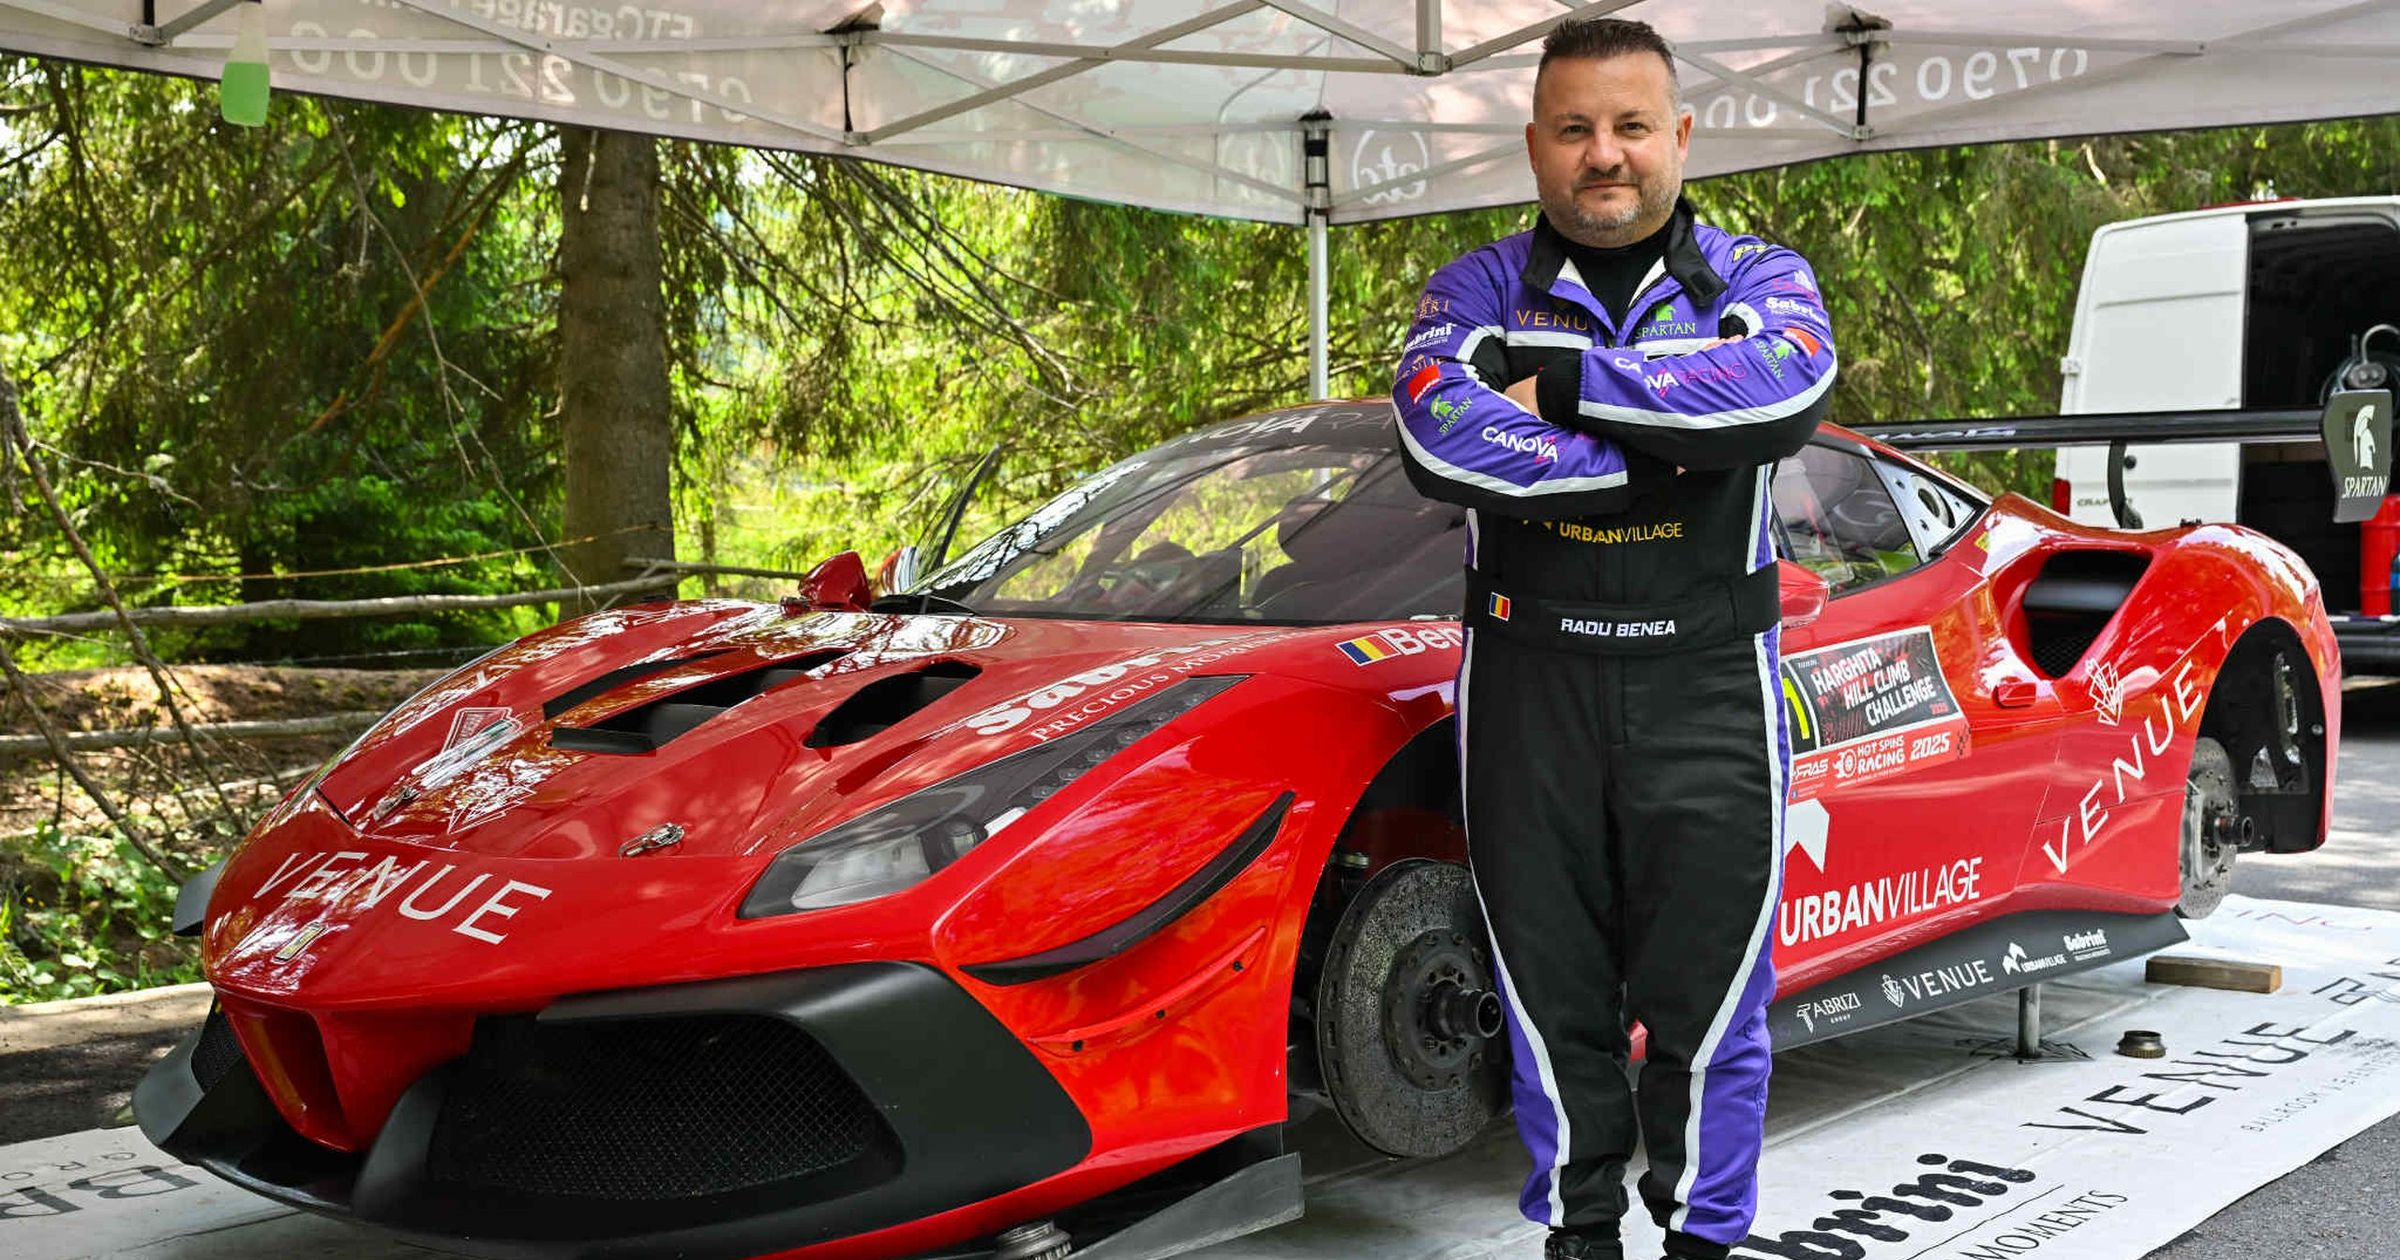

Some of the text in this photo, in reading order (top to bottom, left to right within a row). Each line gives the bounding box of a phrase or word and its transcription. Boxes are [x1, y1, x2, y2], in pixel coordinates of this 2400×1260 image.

[1516, 309, 1588, 331] VENU
[1635, 322, 1697, 339] SPARTAN
[1439, 396, 1474, 435] SPARTAN
[1481, 426, 1559, 463] CANOVA
[2342, 475, 2388, 499] SPARTAN
[1559, 521, 1684, 545] URBANVILLAGE
[1560, 618, 1676, 638] RADU BENEA
[1810, 646, 1883, 696] HARGHITA
[1843, 659, 1912, 711] HILL CLIMB
[1029, 673, 1170, 741] PRECIOUS
[1865, 675, 1937, 727] CHALLENGE
[1857, 731, 1951, 762] HOT SPINS 2025
[1857, 749, 1905, 775] RACING
[2042, 660, 2202, 877] VENUE
[253, 851, 553, 945] VENUE
[1780, 856, 1983, 947] URBANVILLAGE
[1902, 960, 1994, 1000] VENUE
[2019, 1021, 2357, 1136] VENUE
[1728, 1153, 2037, 1260] brini
[1958, 1189, 2129, 1260] MOMENTS
